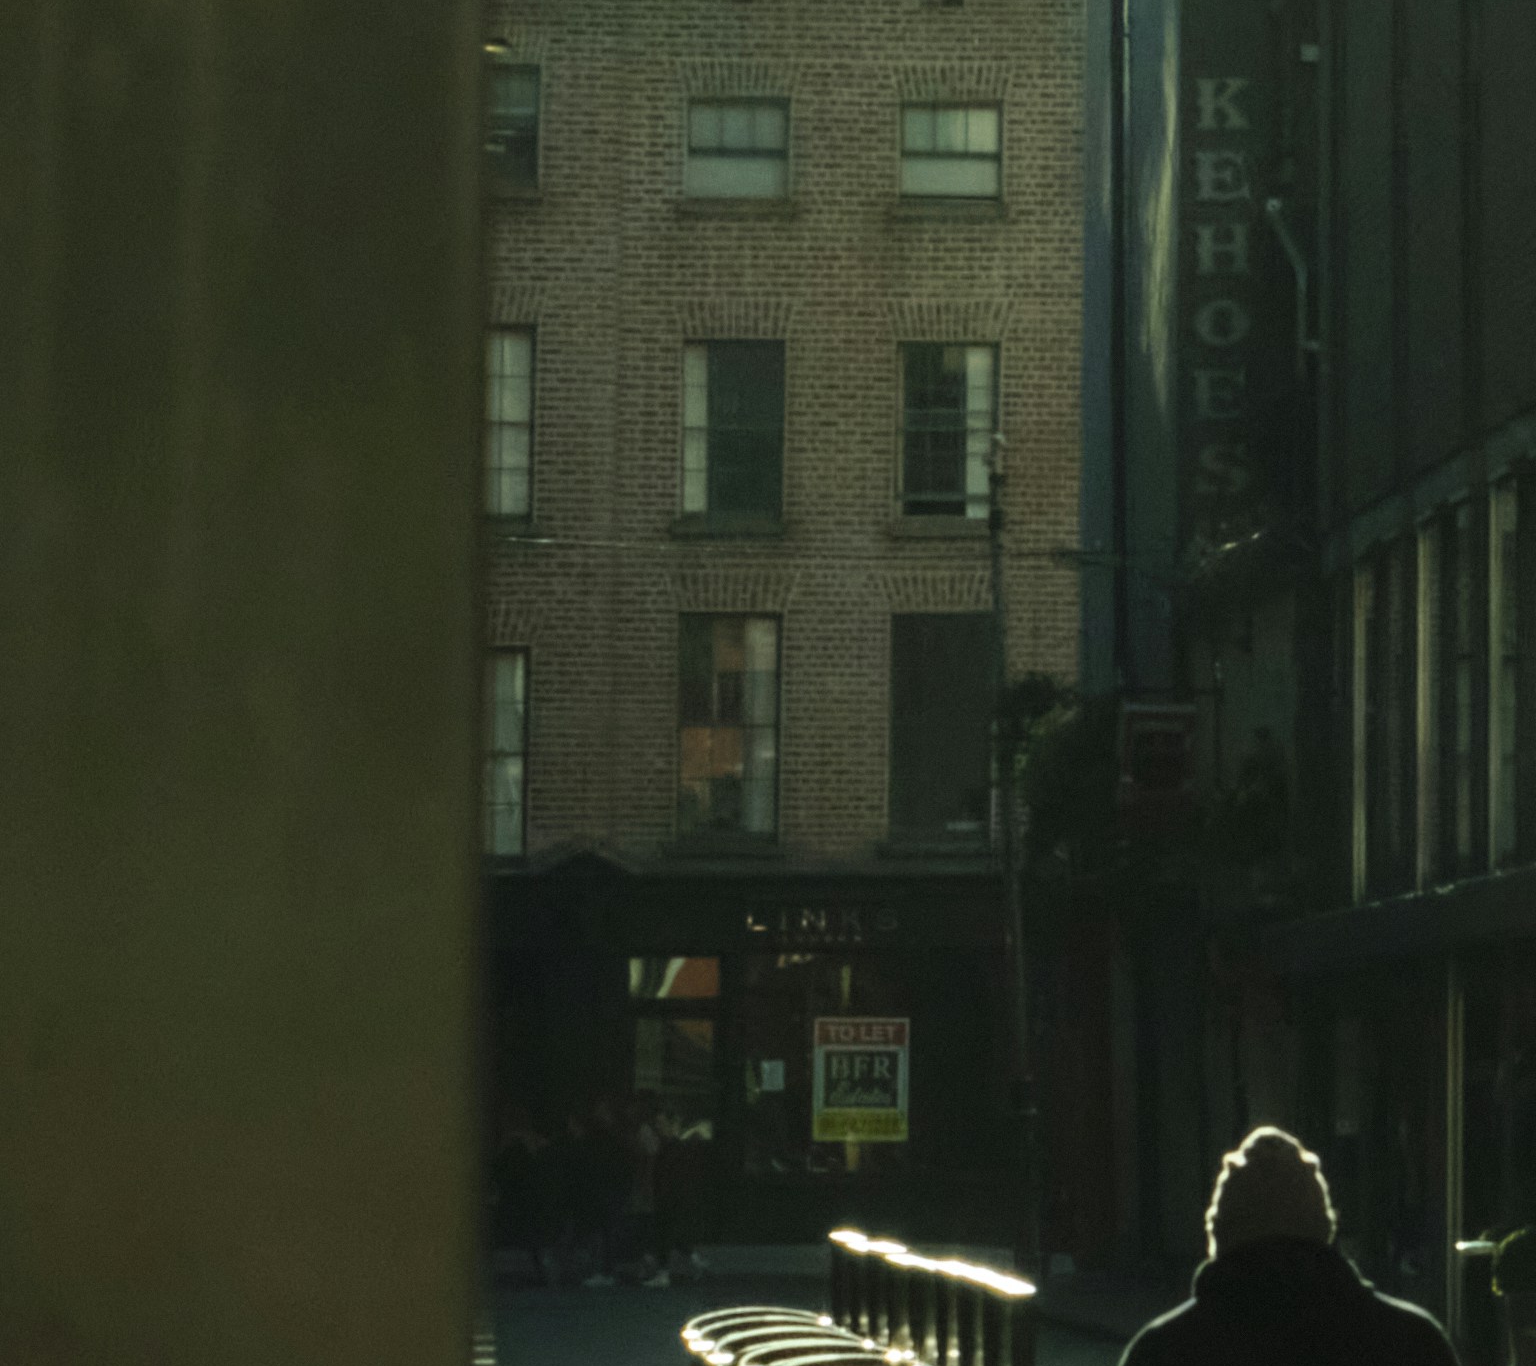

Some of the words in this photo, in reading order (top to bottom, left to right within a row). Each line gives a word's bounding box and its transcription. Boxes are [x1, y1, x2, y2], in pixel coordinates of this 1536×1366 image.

[1192, 76, 1252, 496] KEHOES
[826, 1024, 855, 1042] TO
[858, 1024, 896, 1042] LET
